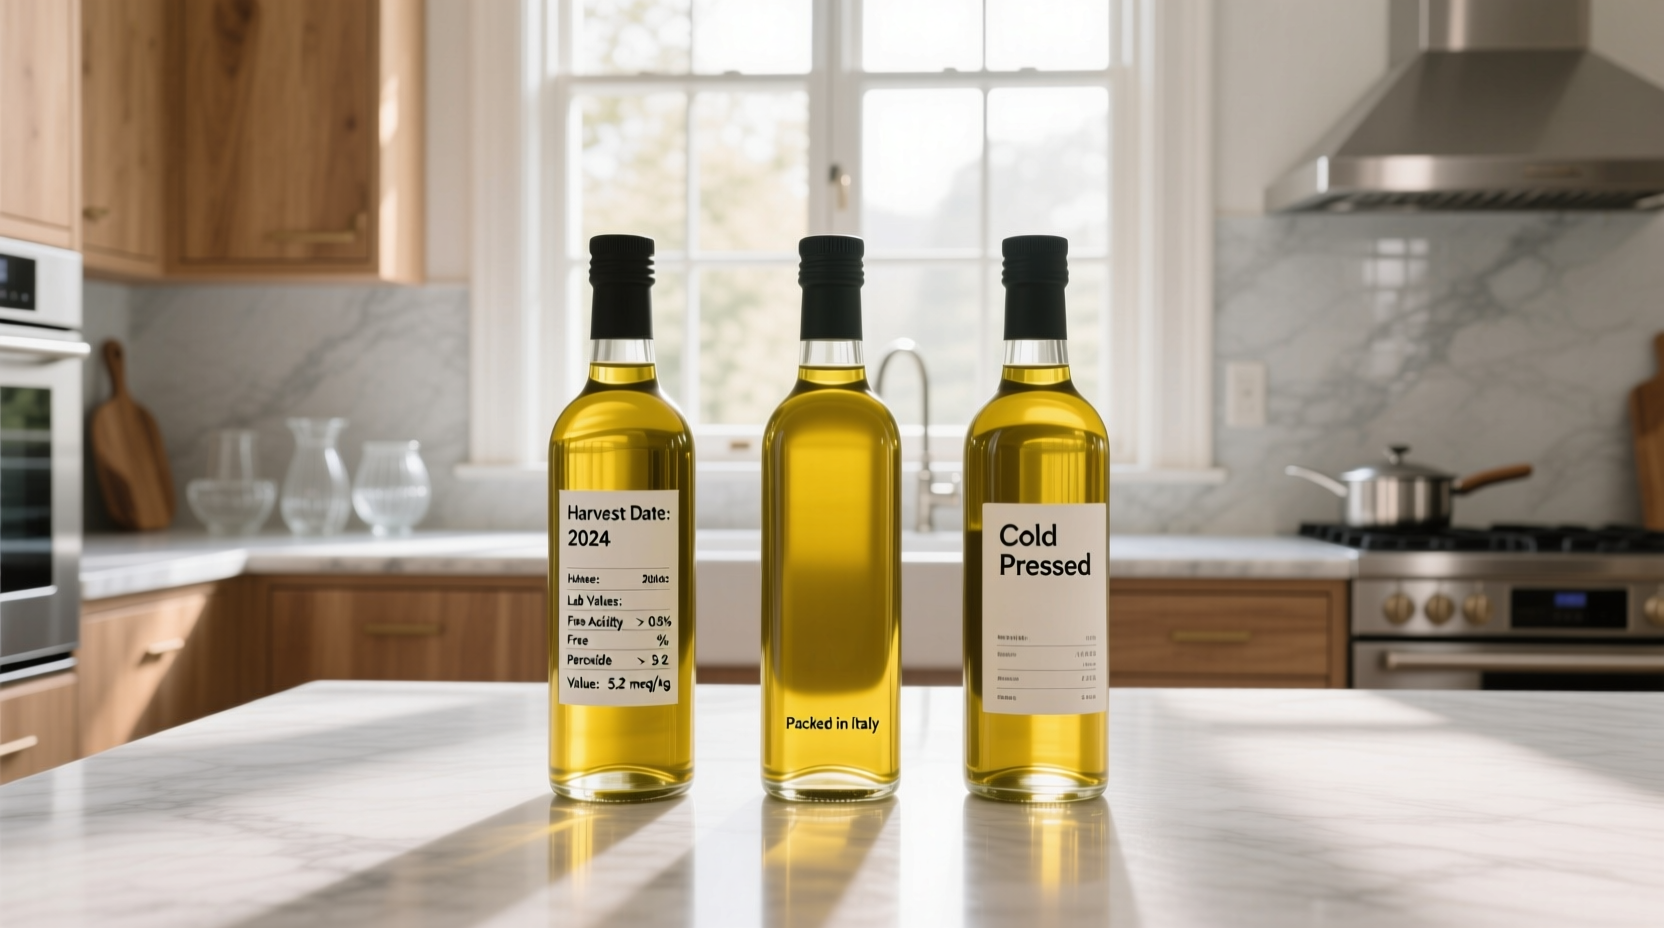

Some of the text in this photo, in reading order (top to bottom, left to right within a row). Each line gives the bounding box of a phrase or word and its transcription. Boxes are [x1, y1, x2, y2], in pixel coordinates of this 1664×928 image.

[567, 504, 671, 521] Harvest Date:
[567, 528, 612, 547] 2024
[999, 523, 1057, 547] Cold
[1000, 552, 1091, 576] Pressed
[566, 676, 600, 690] Value:
[786, 716, 880, 734] Packed in Italy
